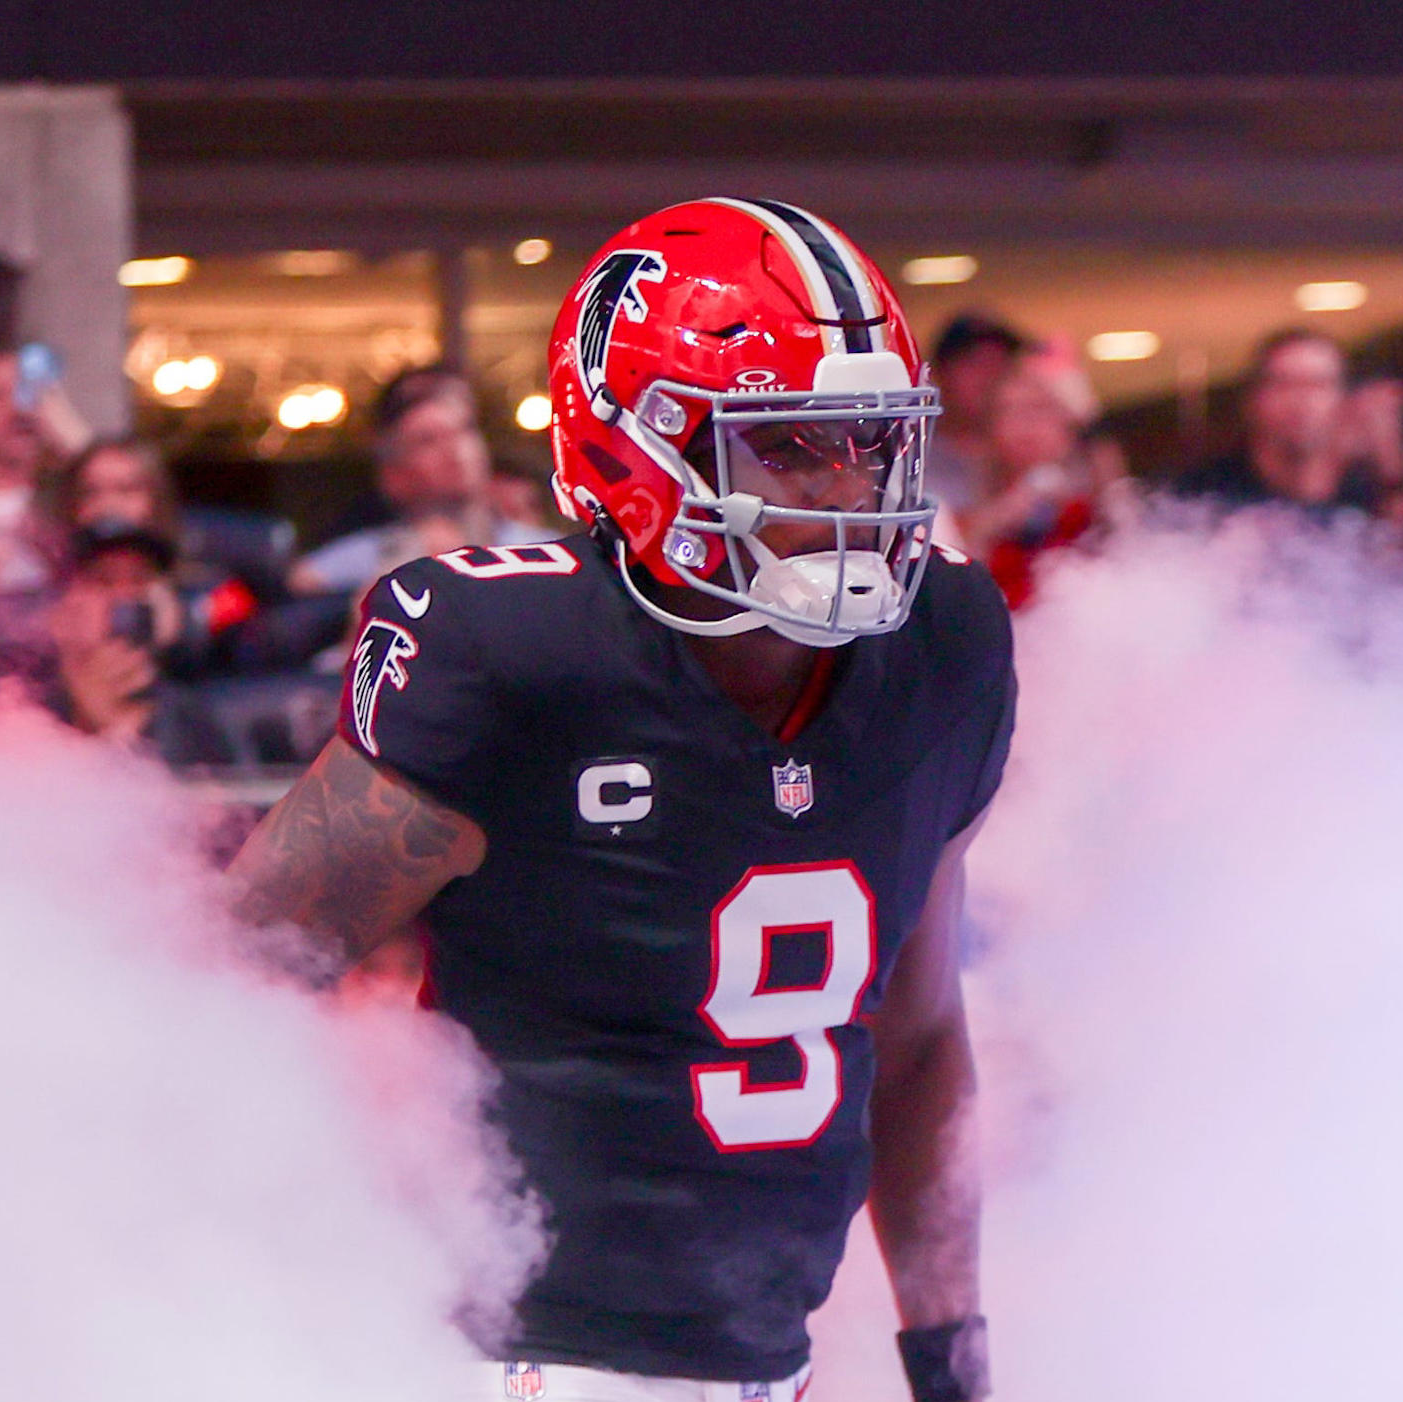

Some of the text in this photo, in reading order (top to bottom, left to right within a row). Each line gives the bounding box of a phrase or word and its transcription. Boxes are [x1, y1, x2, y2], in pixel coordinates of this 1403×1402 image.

[578, 762, 653, 824] C
[780, 785, 809, 807] NFL
[691, 859, 876, 1153] 9
[509, 1375, 541, 1396] NFL
